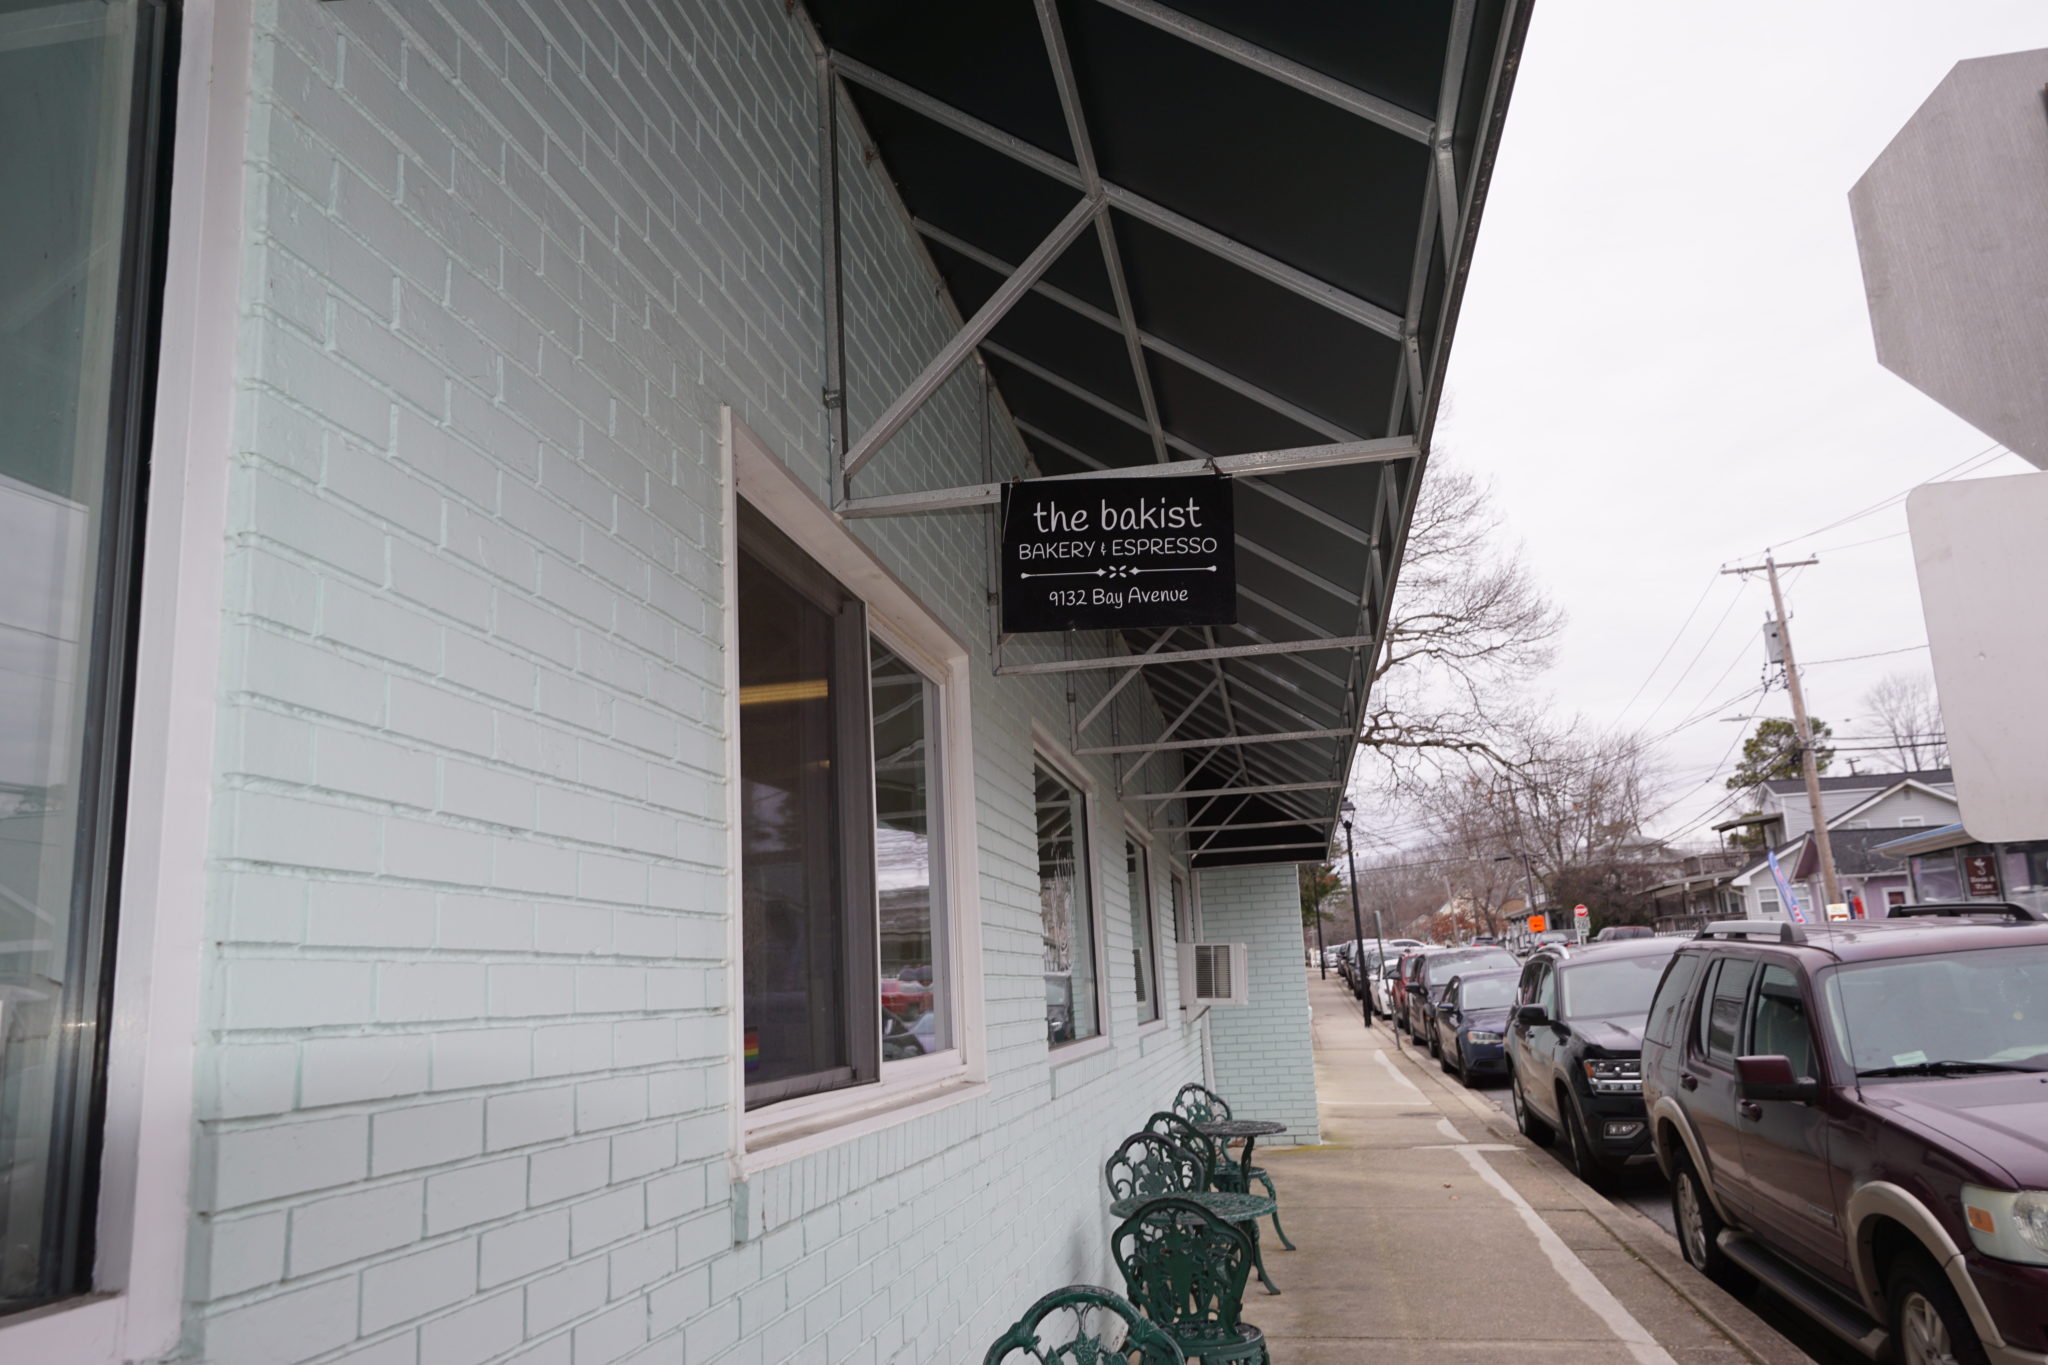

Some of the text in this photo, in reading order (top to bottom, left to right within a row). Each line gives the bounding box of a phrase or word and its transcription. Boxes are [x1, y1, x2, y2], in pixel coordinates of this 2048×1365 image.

[1033, 497, 1203, 533] the bakist
[1019, 537, 1218, 560] BAKERY & ESPRESSO
[1049, 586, 1189, 609] 9132 Bay Avenue
